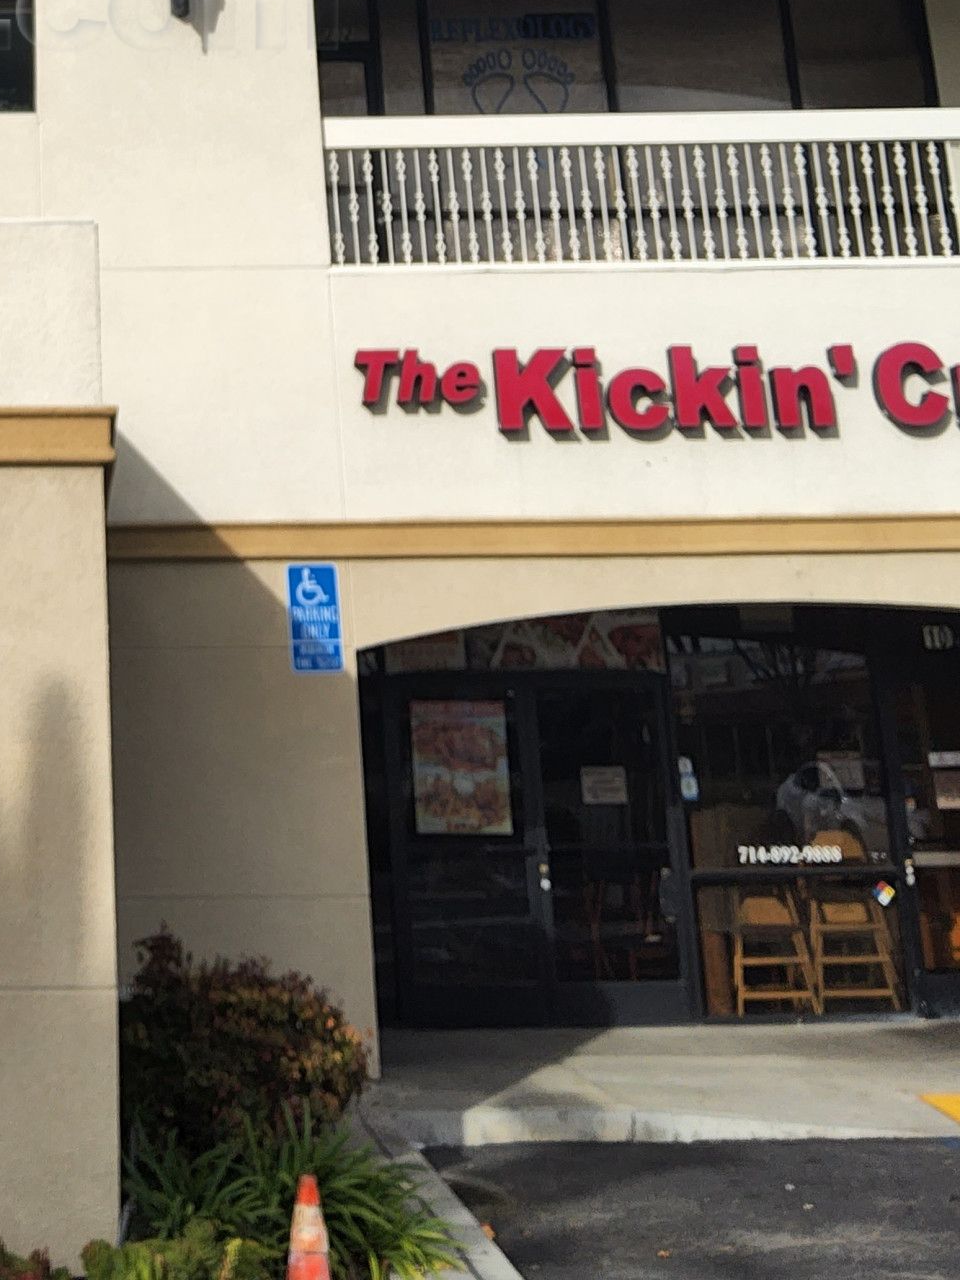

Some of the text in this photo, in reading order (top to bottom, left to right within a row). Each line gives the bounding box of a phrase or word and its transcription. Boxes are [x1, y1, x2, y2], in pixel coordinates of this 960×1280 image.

[355, 342, 960, 433] The Kickin' C
